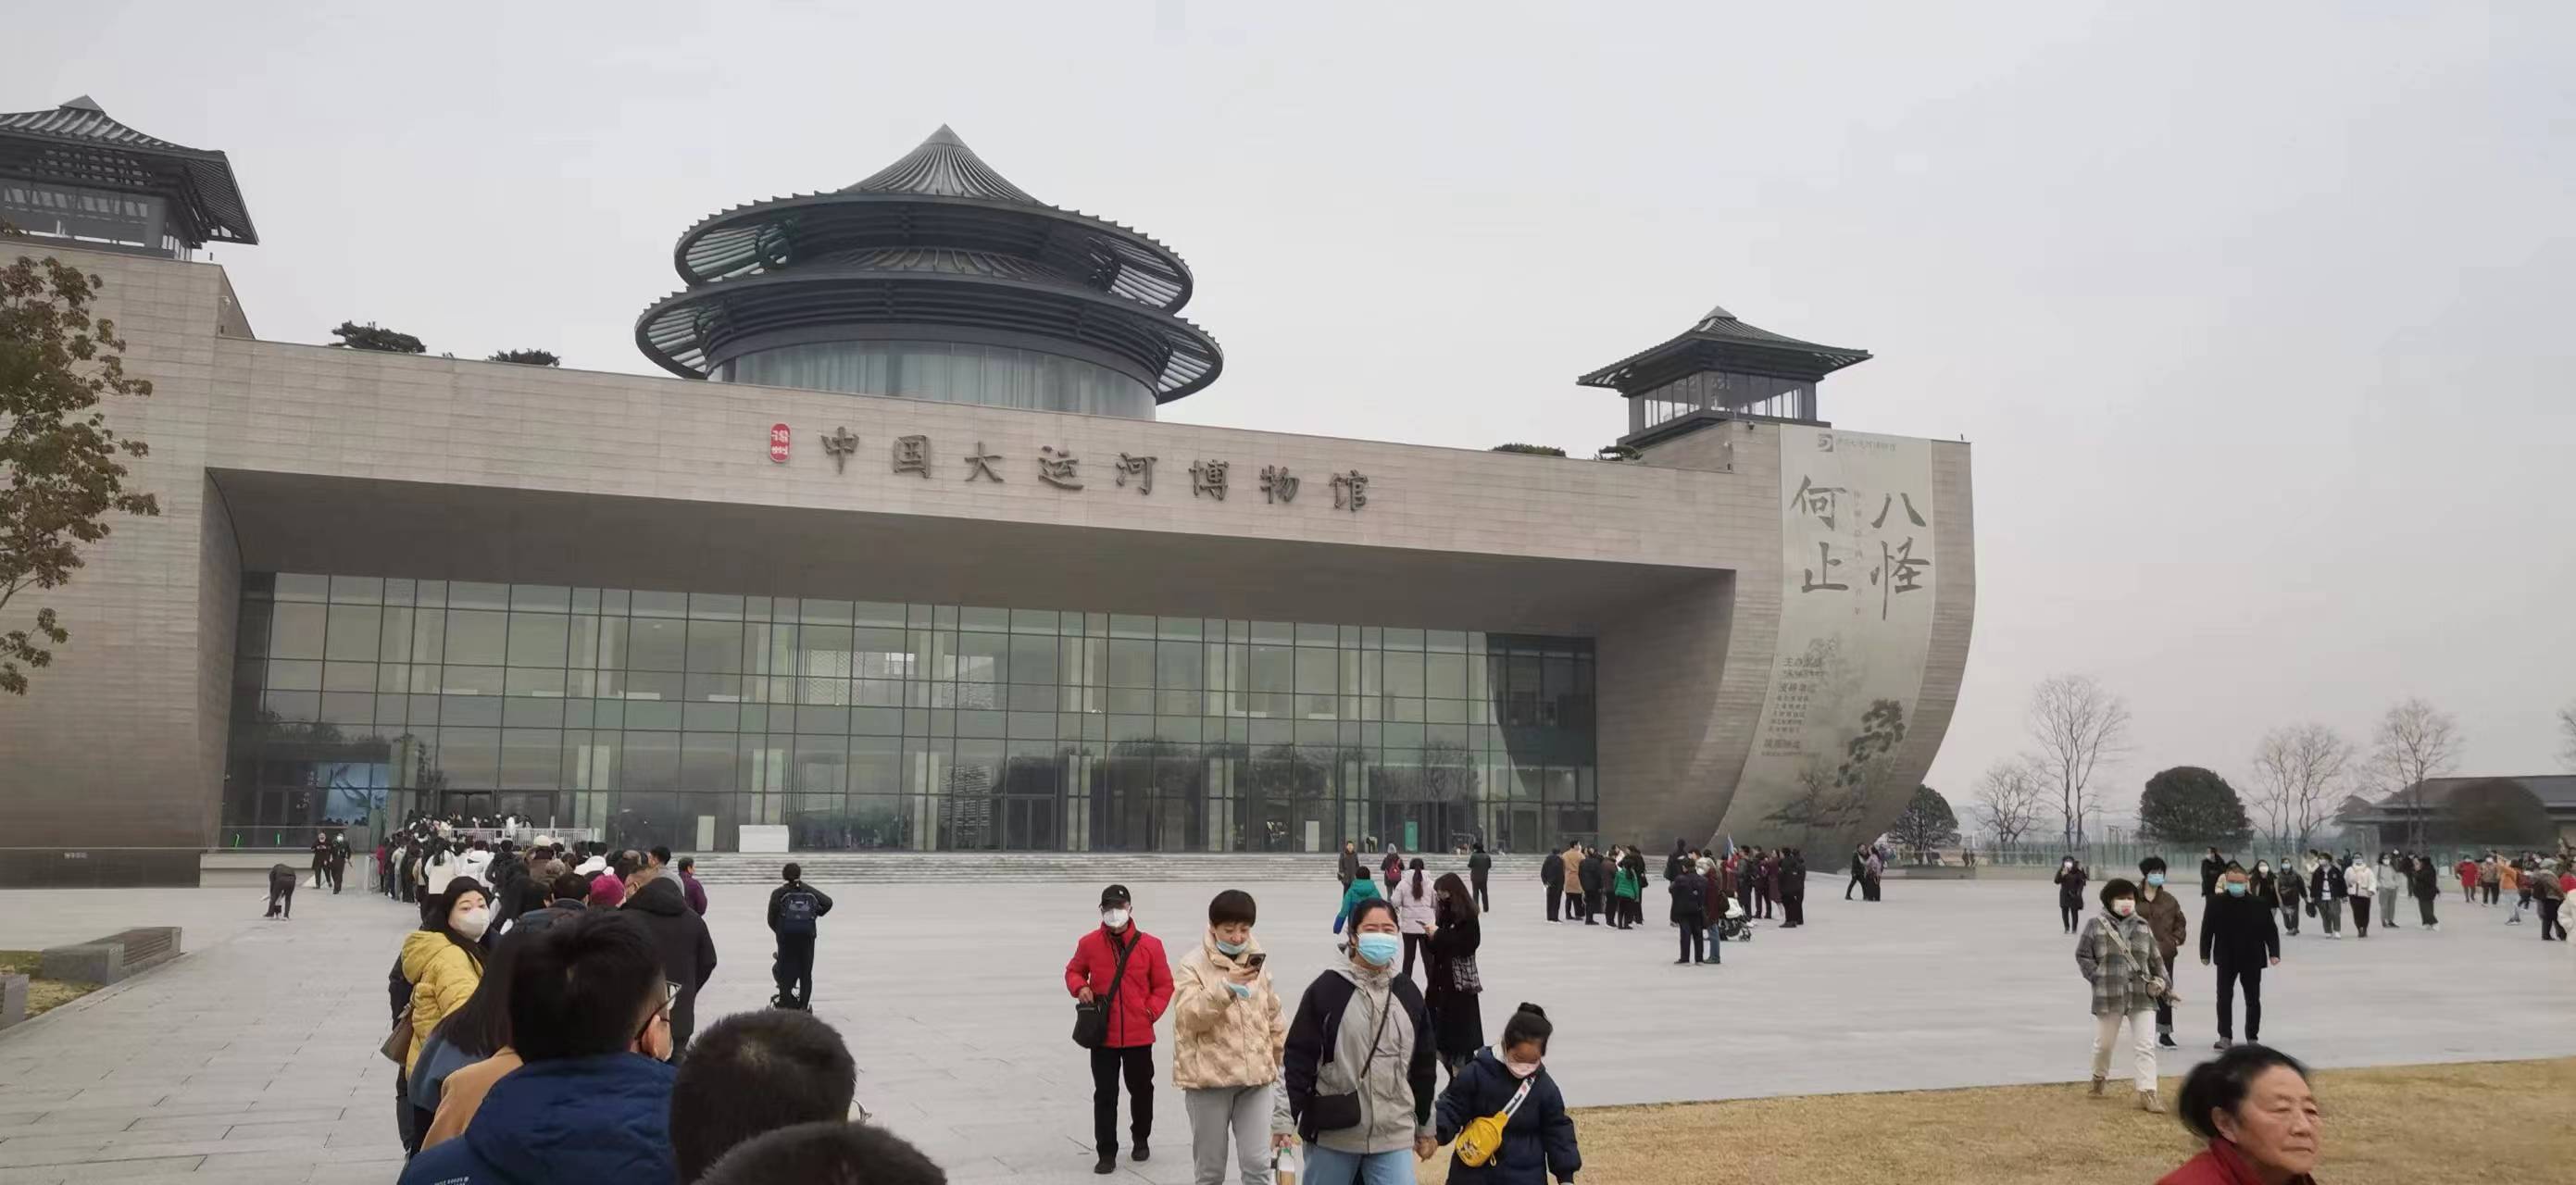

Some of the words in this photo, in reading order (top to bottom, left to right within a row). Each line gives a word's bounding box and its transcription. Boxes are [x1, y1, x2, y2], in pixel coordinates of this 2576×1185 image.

[819, 425, 1369, 513] 中国大运河博物馆
[1790, 474, 1849, 593] 何止
[1869, 493, 1931, 621] 八怪
